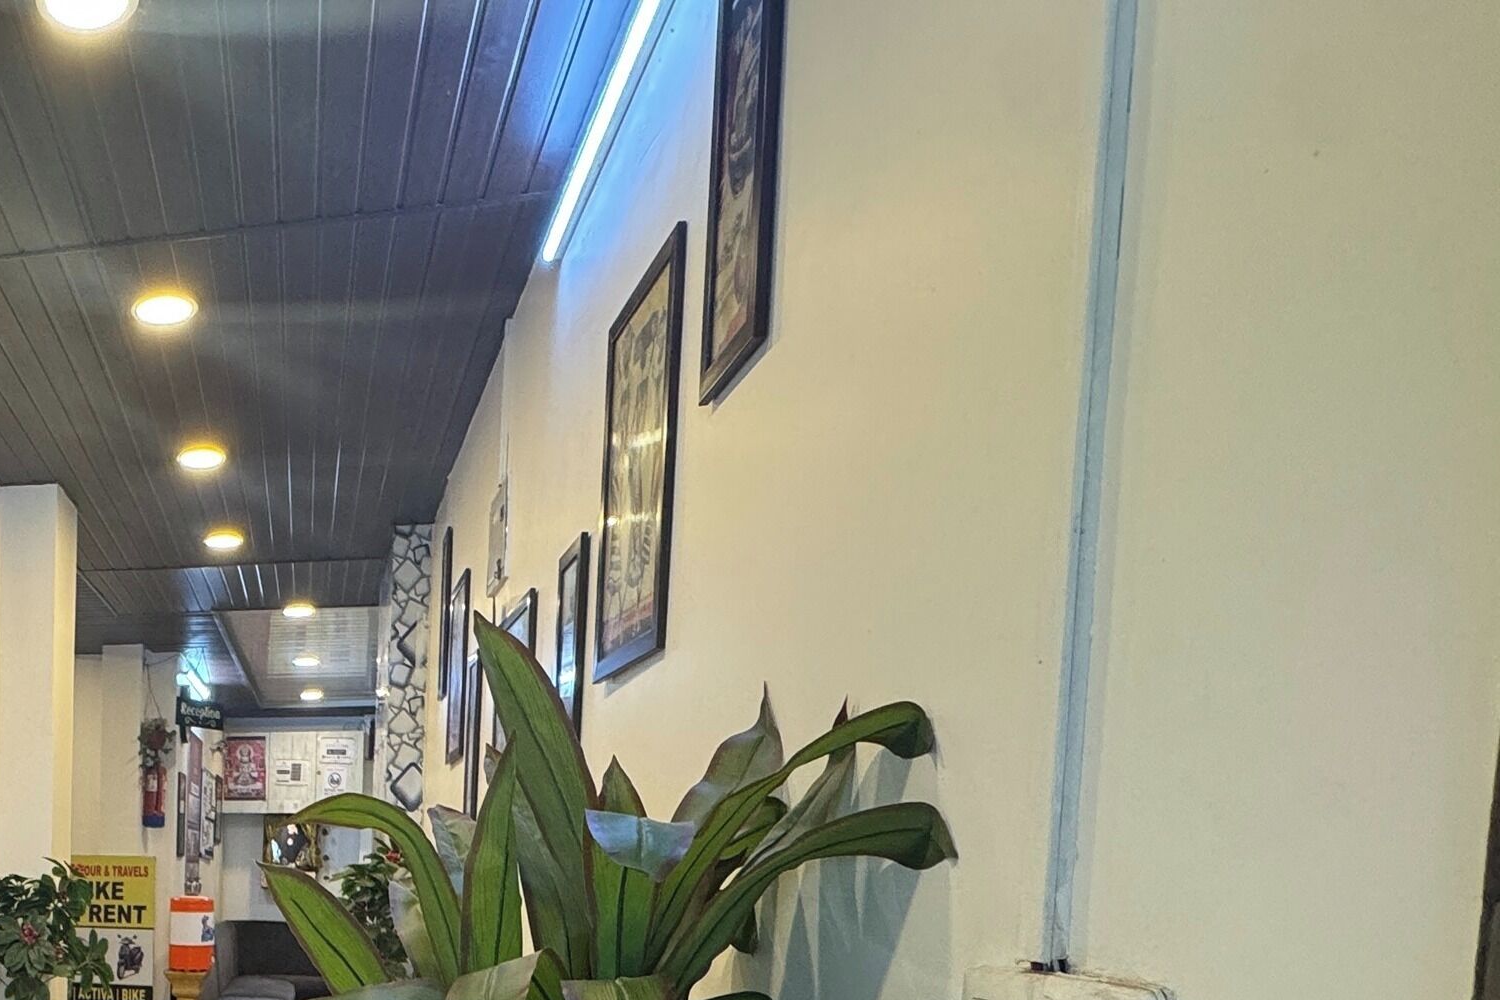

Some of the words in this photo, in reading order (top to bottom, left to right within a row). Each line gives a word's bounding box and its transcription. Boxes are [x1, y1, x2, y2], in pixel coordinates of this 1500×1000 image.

[79, 864, 102, 877] OUR
[112, 865, 149, 878] TRAVELS
[89, 904, 147, 924] RENT
